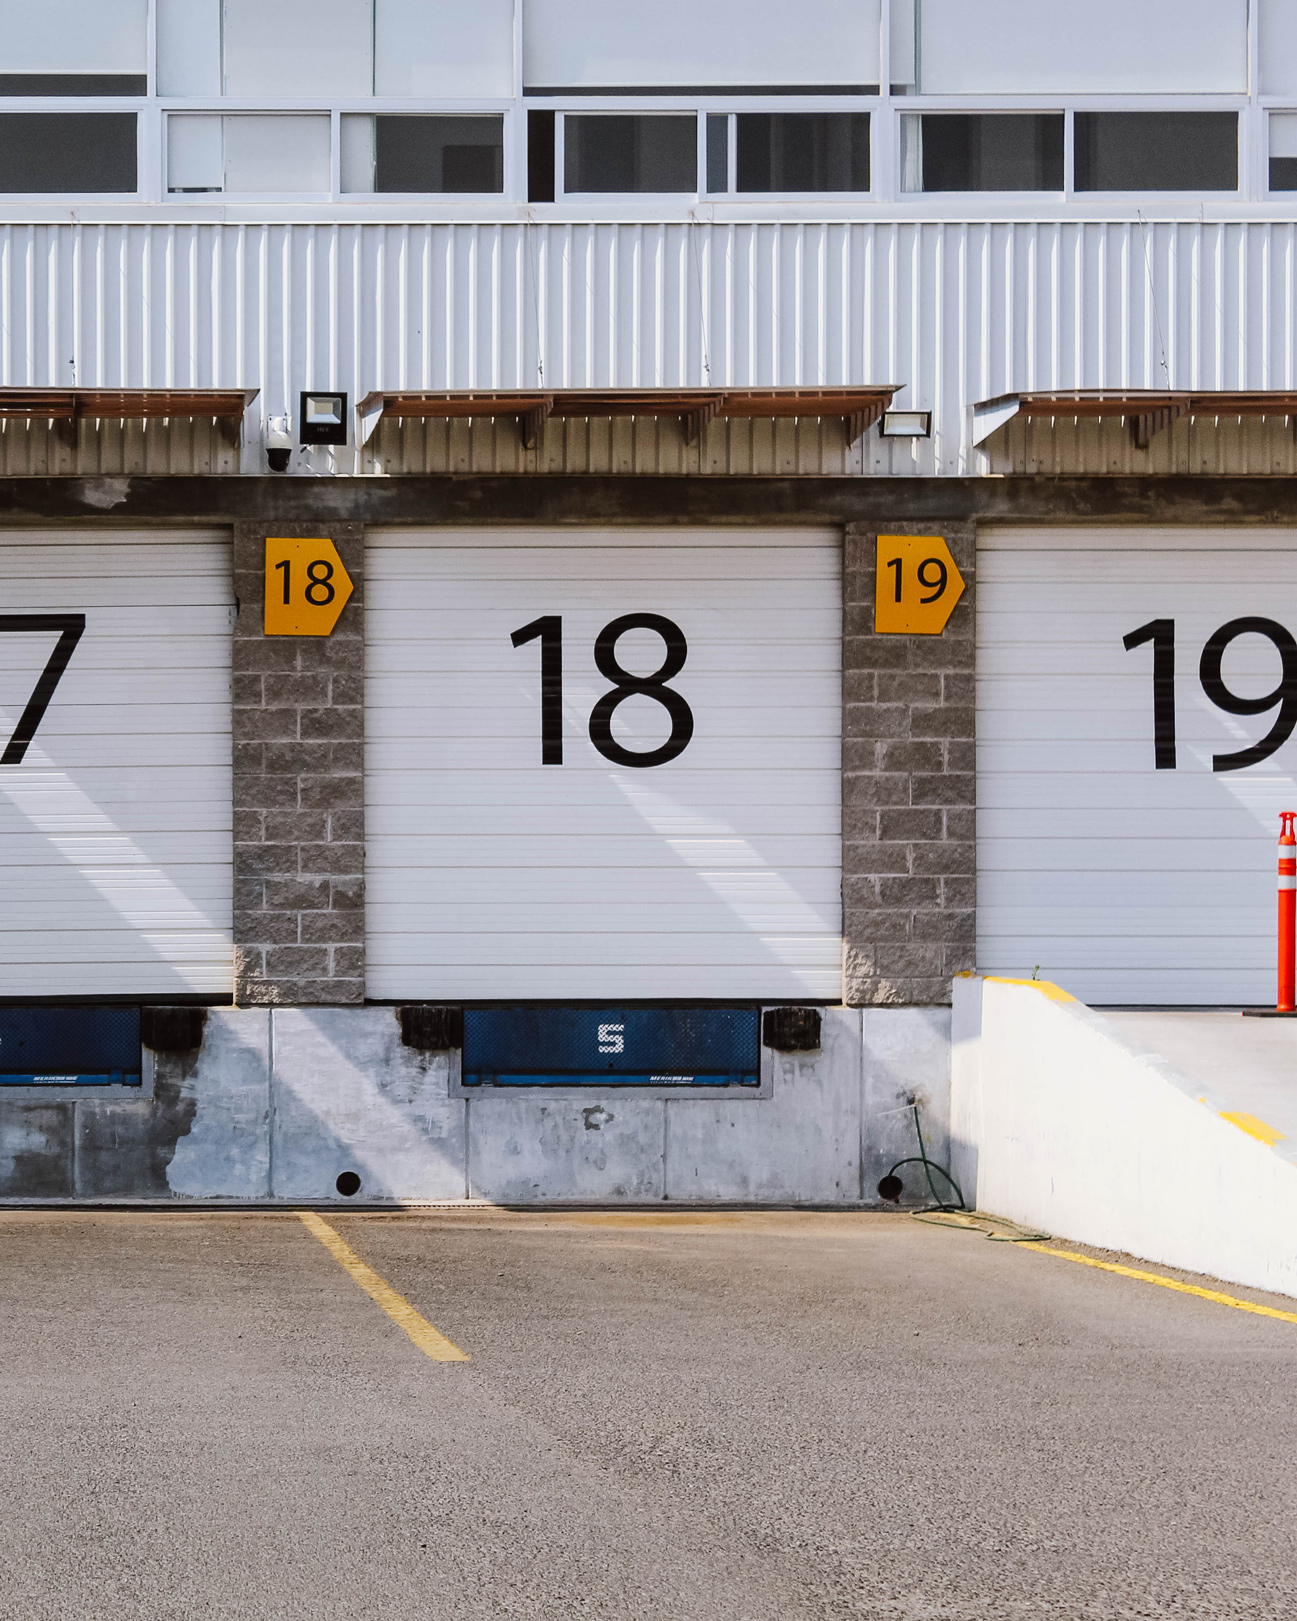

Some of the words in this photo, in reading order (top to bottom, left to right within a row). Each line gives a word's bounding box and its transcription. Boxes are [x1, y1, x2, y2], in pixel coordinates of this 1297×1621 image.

[274, 559, 336, 607] 18
[886, 558, 948, 604] 19
[510, 612, 694, 768] 18
[1122, 616, 1297, 772] 19
[598, 1024, 624, 1053] 5
